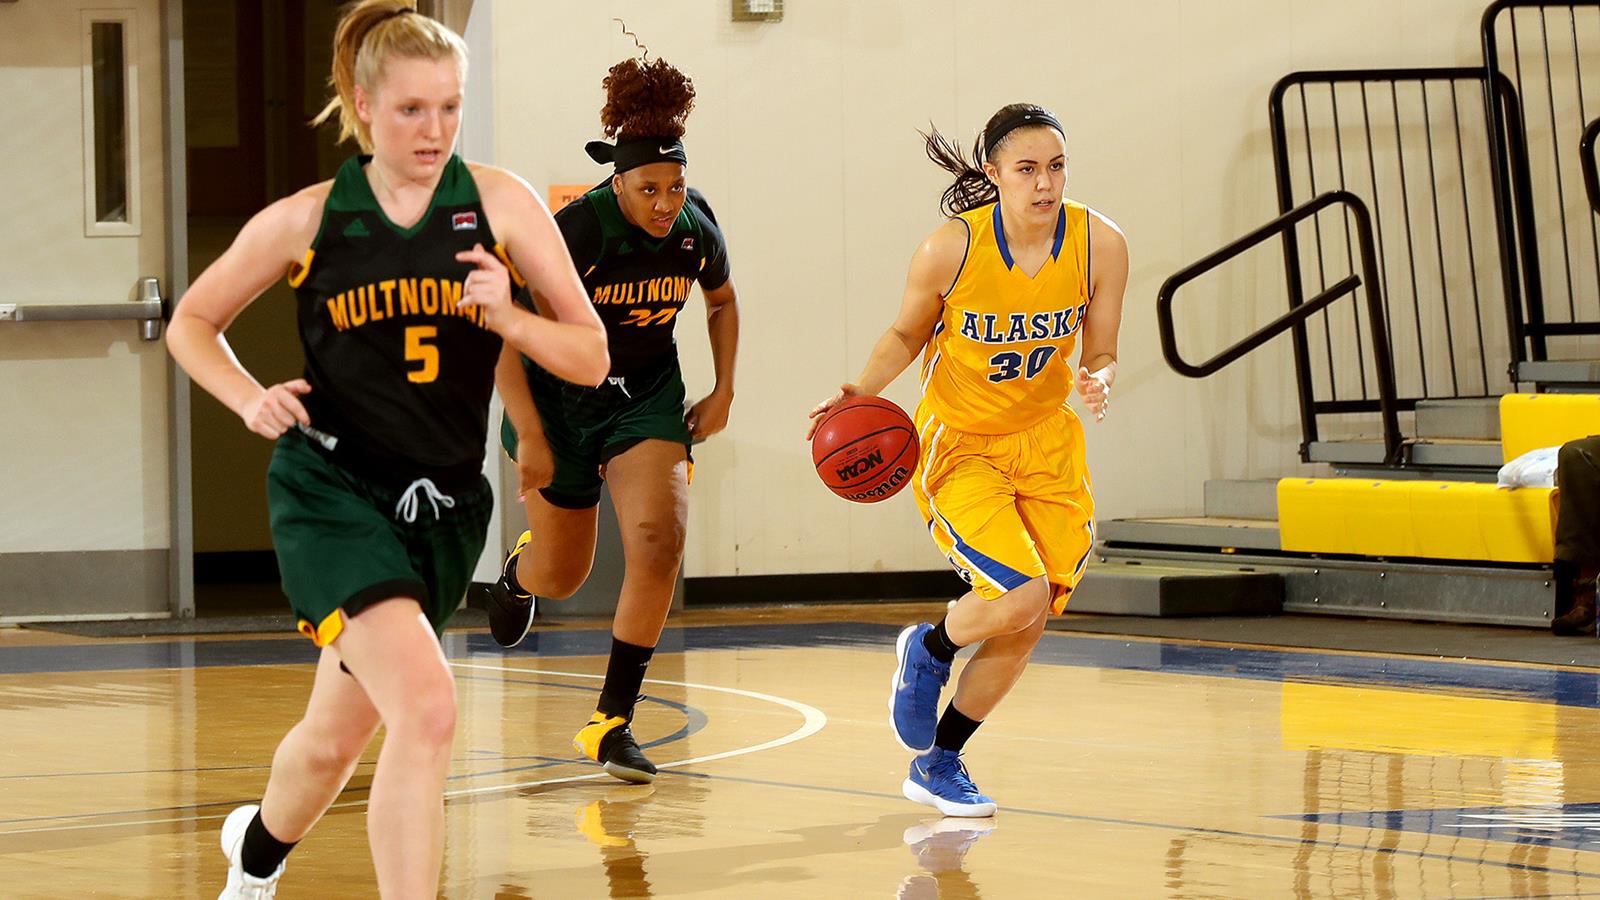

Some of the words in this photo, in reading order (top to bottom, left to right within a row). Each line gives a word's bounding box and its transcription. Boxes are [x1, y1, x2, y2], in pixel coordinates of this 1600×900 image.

[405, 326, 439, 383] 5
[987, 346, 1057, 383] 30
[836, 449, 884, 482] NCAA
